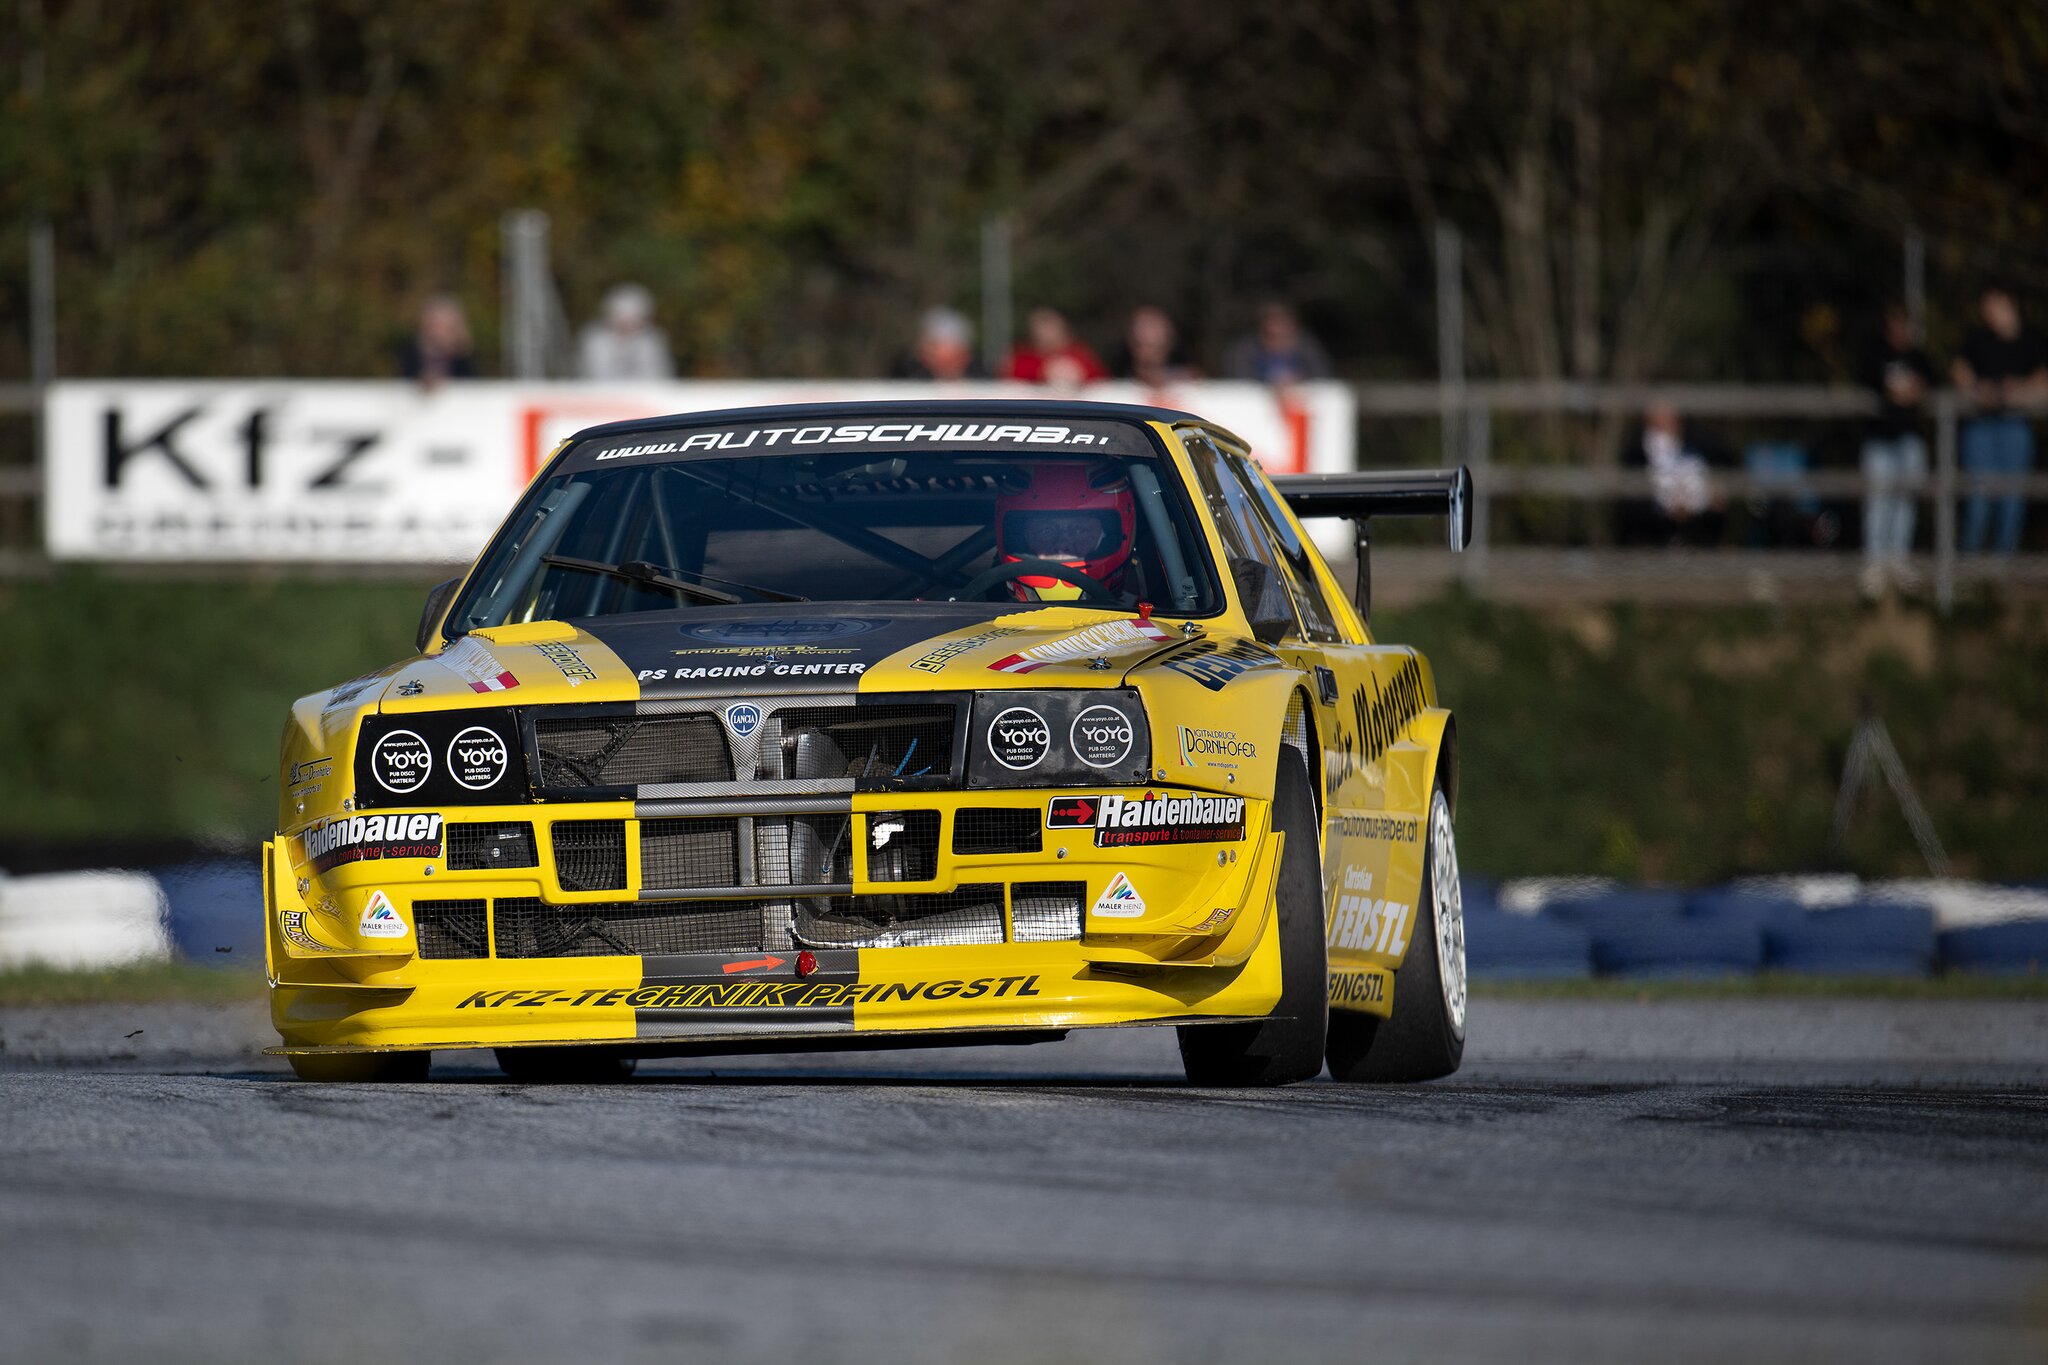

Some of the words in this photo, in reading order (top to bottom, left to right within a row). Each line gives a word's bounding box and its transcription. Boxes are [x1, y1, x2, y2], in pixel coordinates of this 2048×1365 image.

[637, 668, 666, 681] PS
[674, 665, 766, 680] RACING
[773, 662, 866, 676] CENTER
[733, 714, 755, 724] LANCIA
[999, 727, 1048, 746] YOYO
[1082, 725, 1131, 744] YOYO
[383, 750, 431, 769] YOYO
[458, 747, 506, 766] YOYO
[1097, 792, 1245, 827] Haidenbauer
[304, 814, 444, 861] Haidenbauer
[1172, 828, 1179, 841] &
[1123, 902, 1142, 910] HEINZ
[361, 922, 383, 930] MALER
[1329, 895, 1410, 957] FERSTL
[456, 983, 808, 1009] KFZ-TECHNIK
[795, 974, 1040, 1008] PFINGSTL
[1328, 973, 1384, 1002] FINGSTL
